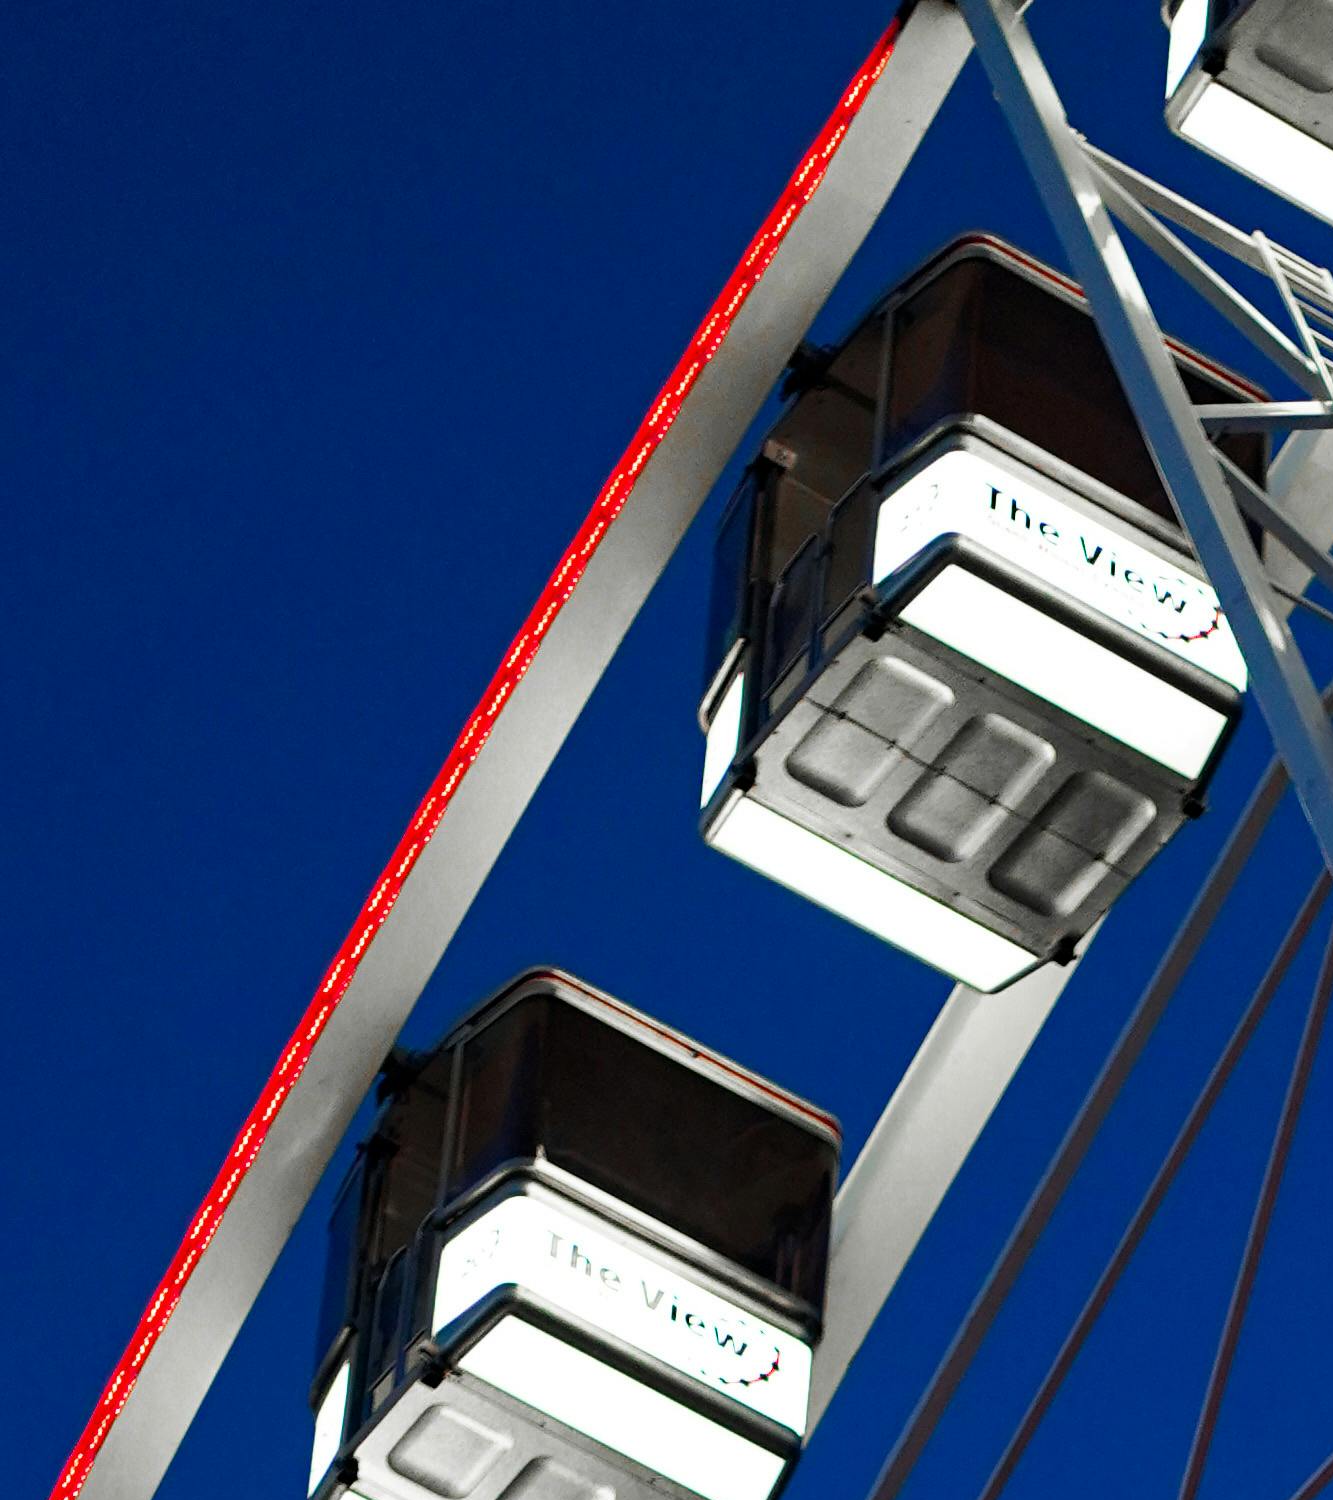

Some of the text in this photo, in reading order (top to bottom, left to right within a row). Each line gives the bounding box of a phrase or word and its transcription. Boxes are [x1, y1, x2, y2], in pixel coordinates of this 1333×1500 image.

[985, 482, 1060, 546] The
[1079, 535, 1187, 613] View
[548, 1230, 748, 1356] The View
